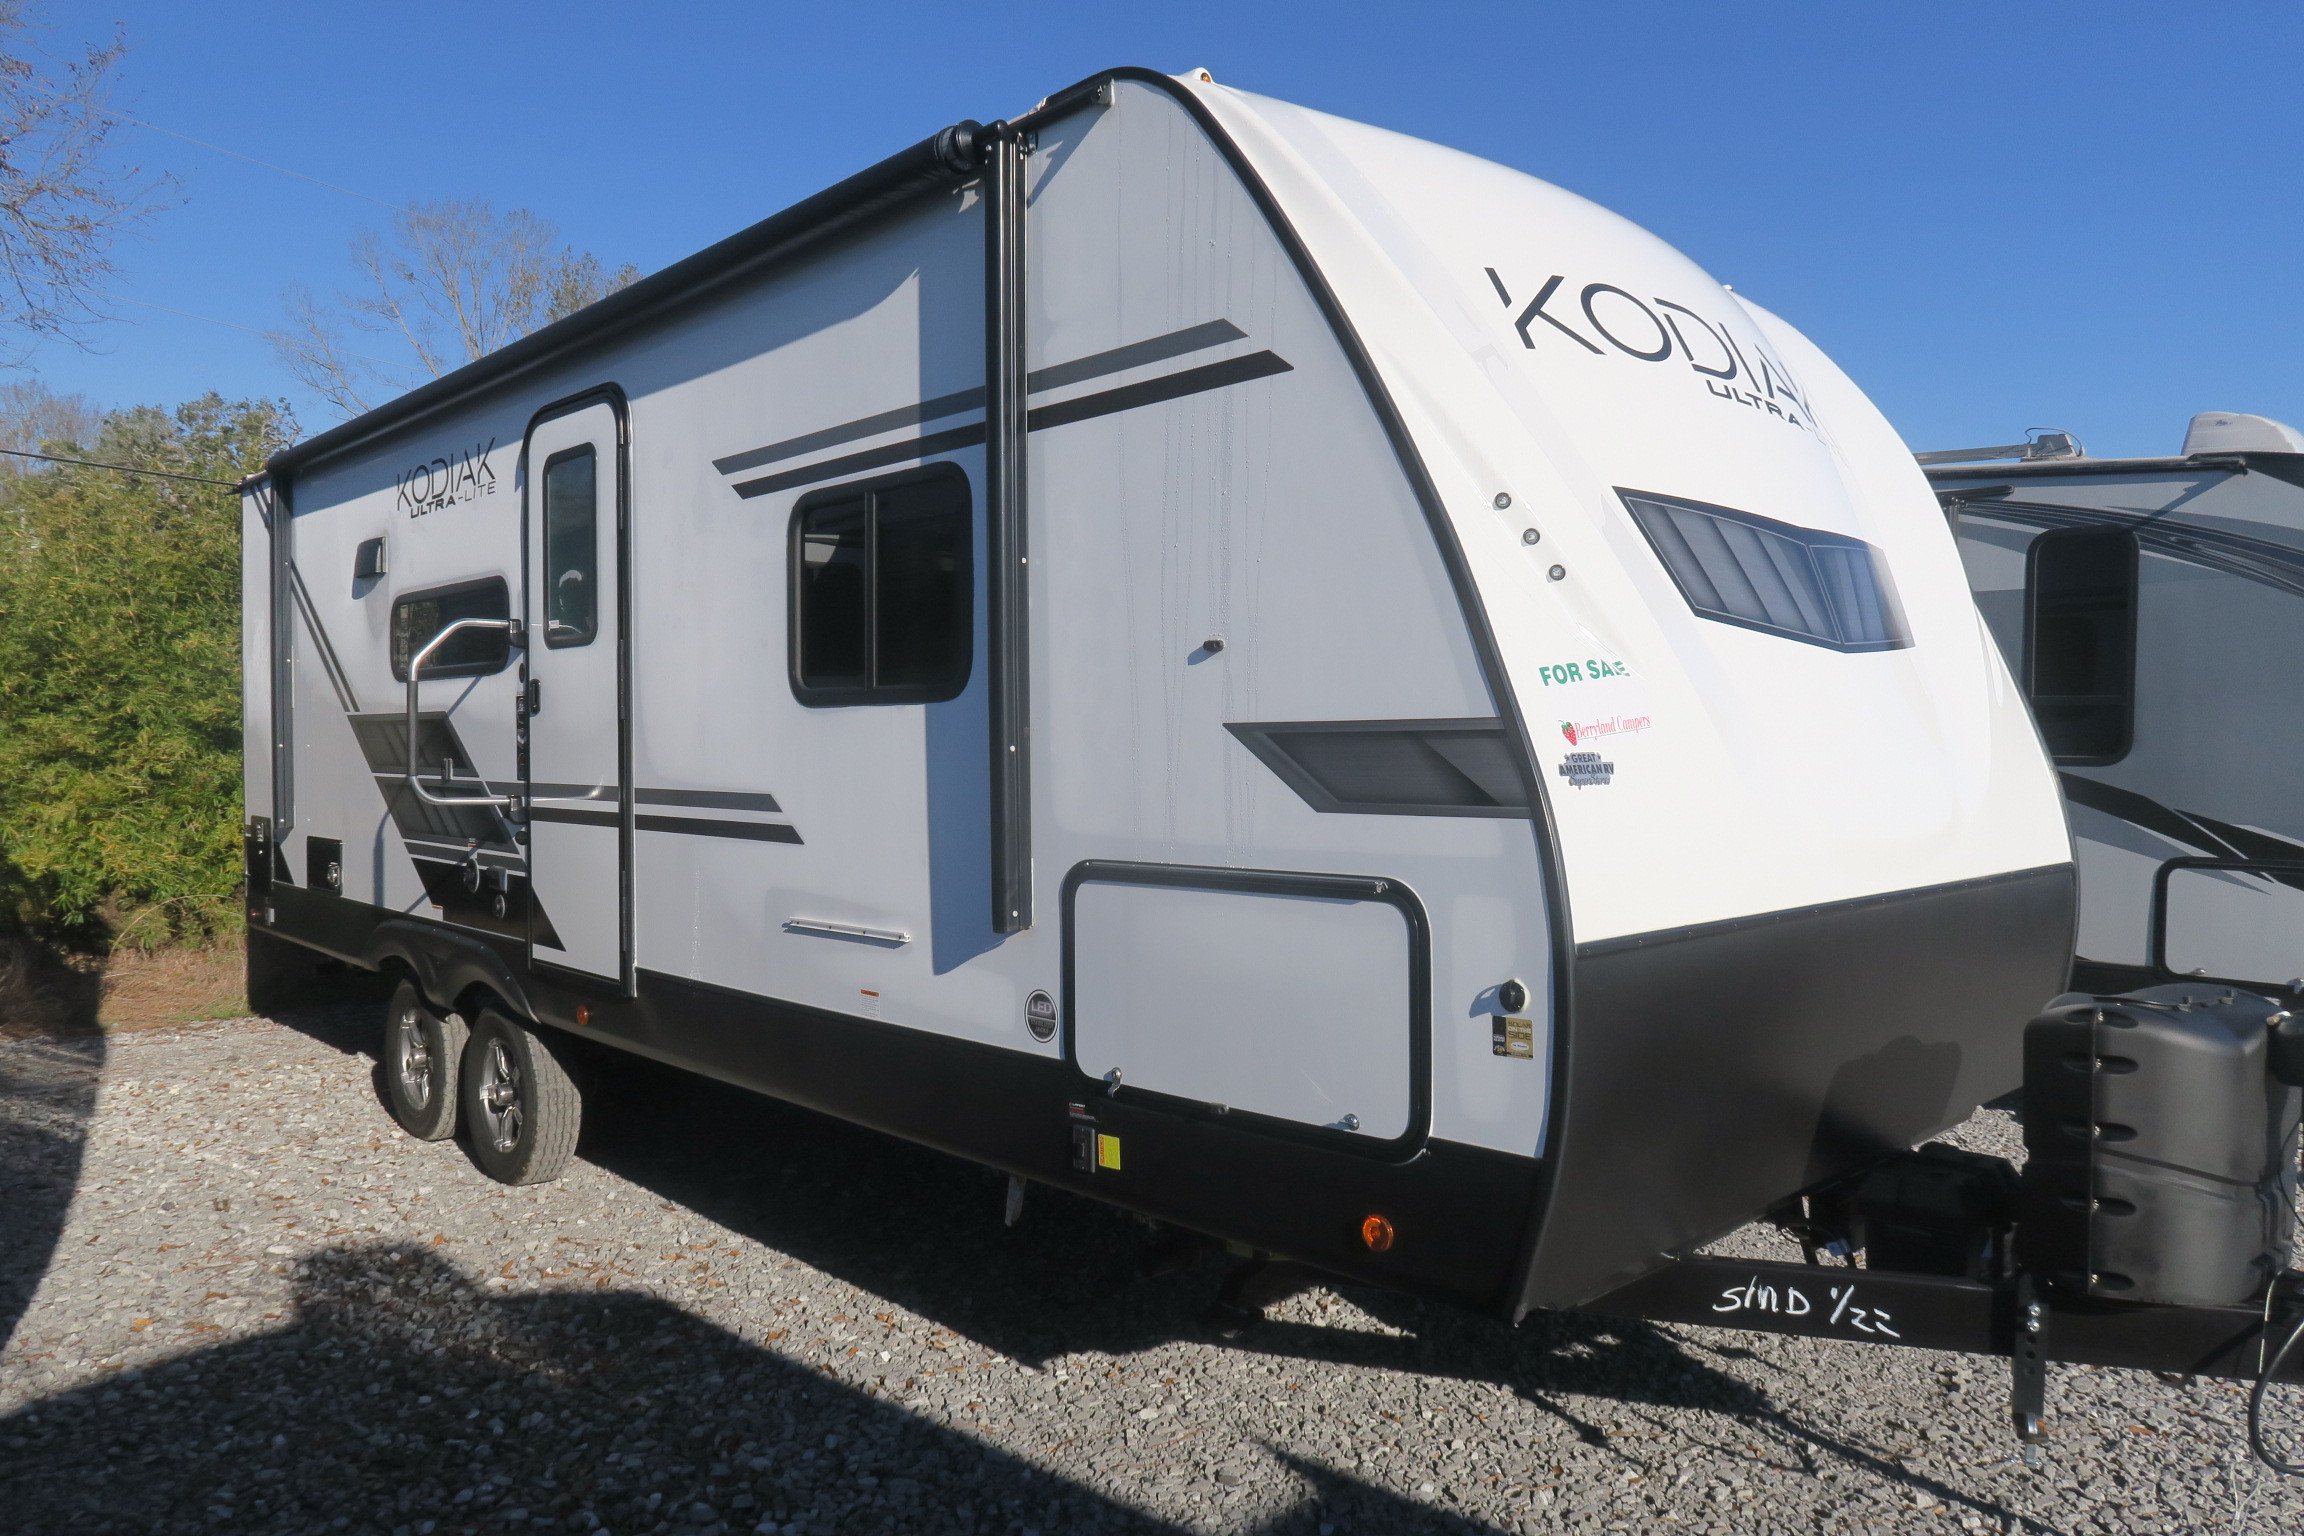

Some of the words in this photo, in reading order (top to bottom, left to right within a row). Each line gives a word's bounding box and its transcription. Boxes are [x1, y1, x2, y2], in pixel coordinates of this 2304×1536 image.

[397, 437, 496, 511] KODIAK
[410, 481, 496, 519] ULTRA-LITE
[1539, 662, 1583, 686] FOR
[1575, 717, 1616, 740] Berryland
[1617, 715, 1651, 733] Campers
[1571, 753, 1596, 763] GREAT
[1559, 764, 1602, 776] AMERICAN
[1603, 763, 1614, 775] RV
[1031, 999, 1052, 1014] LED
[1507, 1031, 1532, 1041] SIDE
